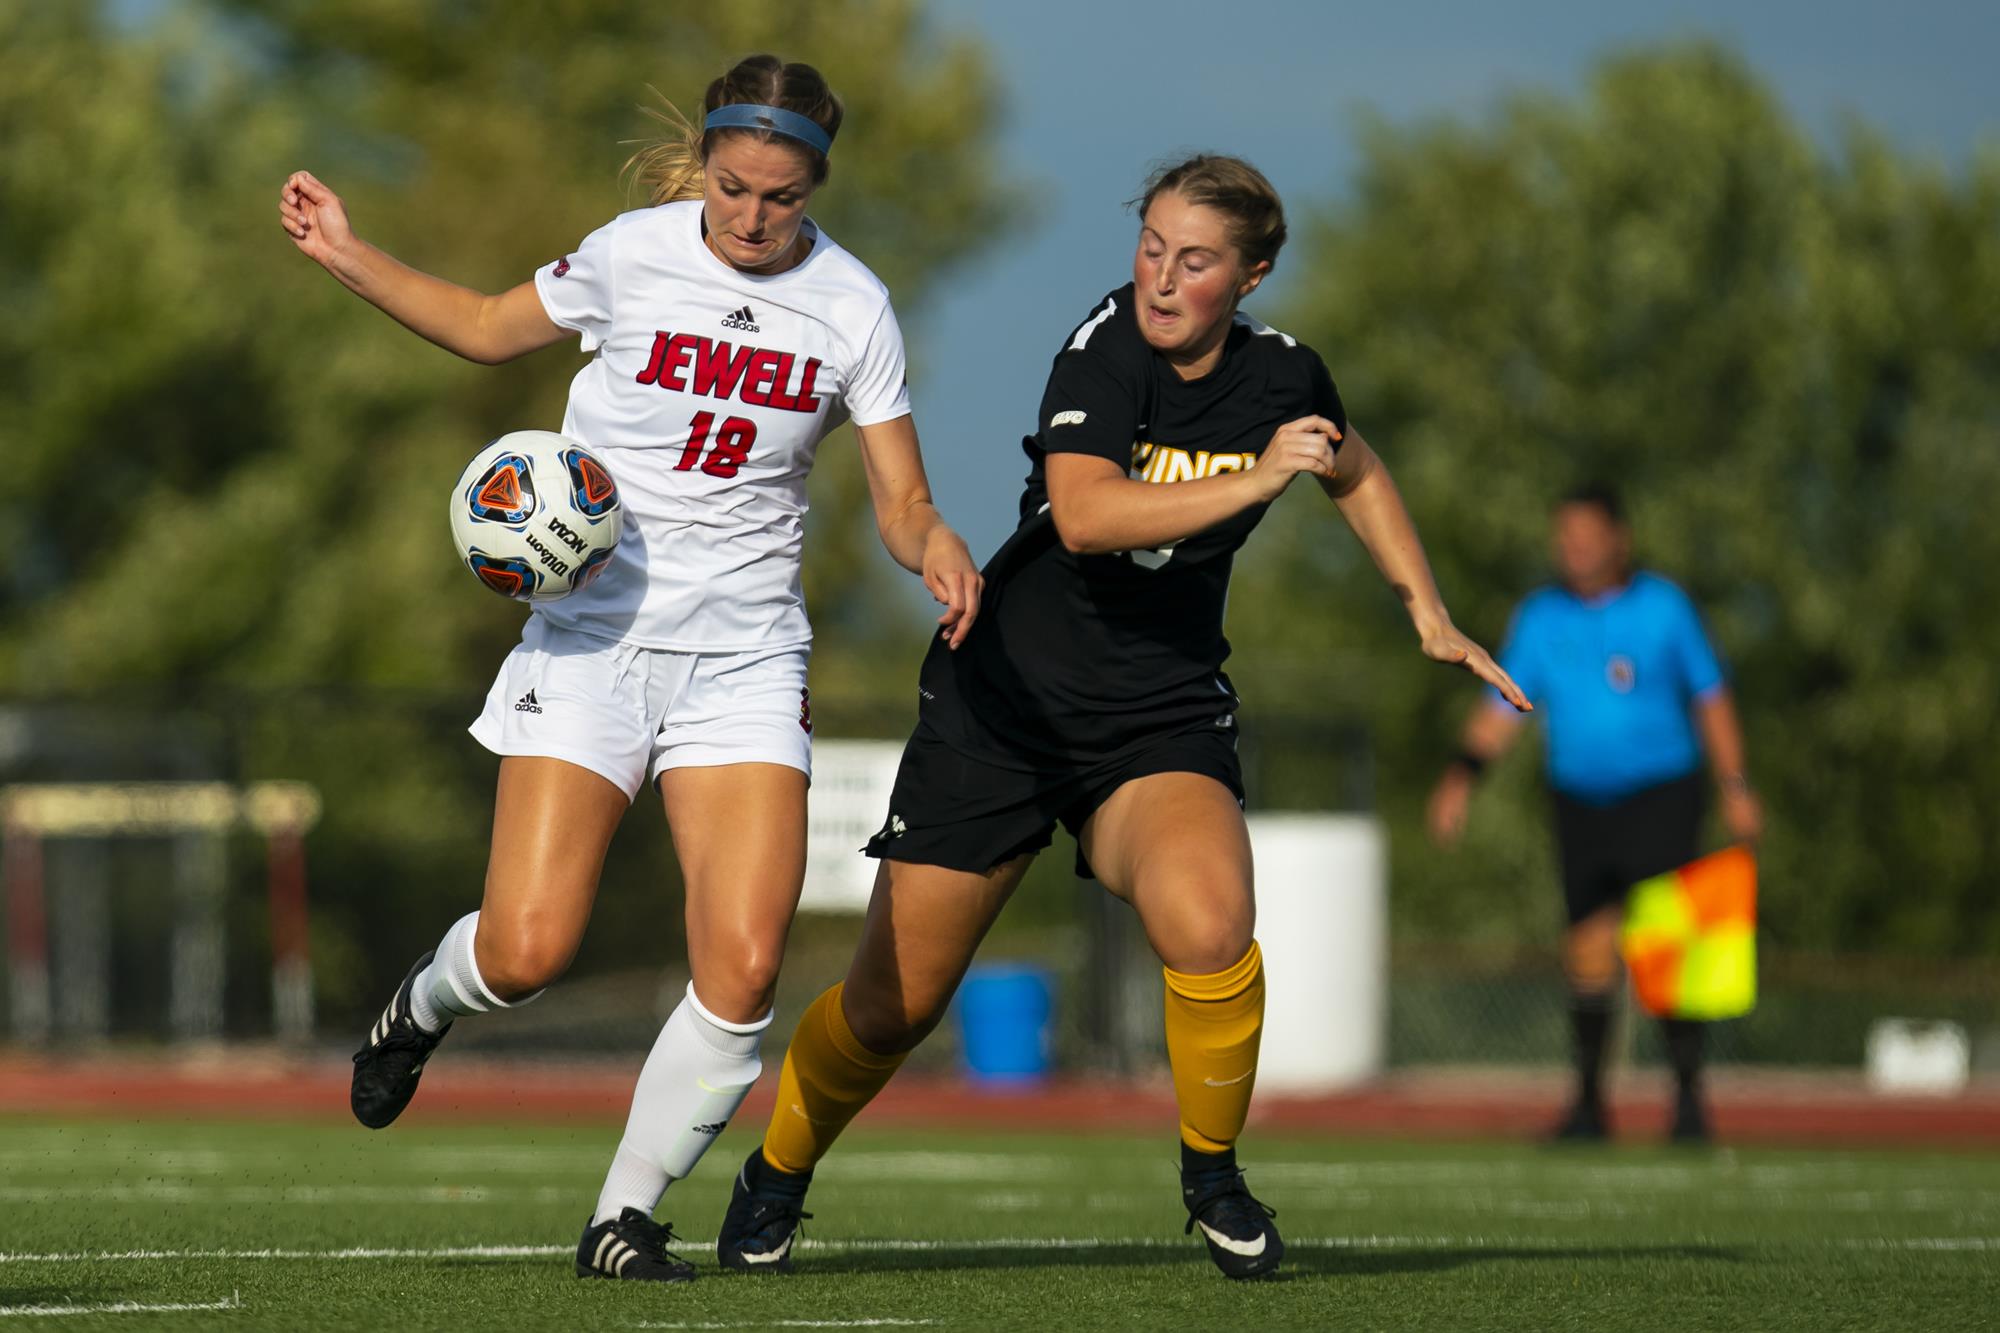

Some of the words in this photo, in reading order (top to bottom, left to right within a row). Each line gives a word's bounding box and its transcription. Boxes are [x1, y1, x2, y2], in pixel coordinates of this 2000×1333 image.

[721, 319, 760, 333] adidas
[636, 330, 822, 413] JEWELL
[672, 410, 757, 479] 18
[525, 534, 569, 577] Wilson
[547, 516, 588, 554] NCAA
